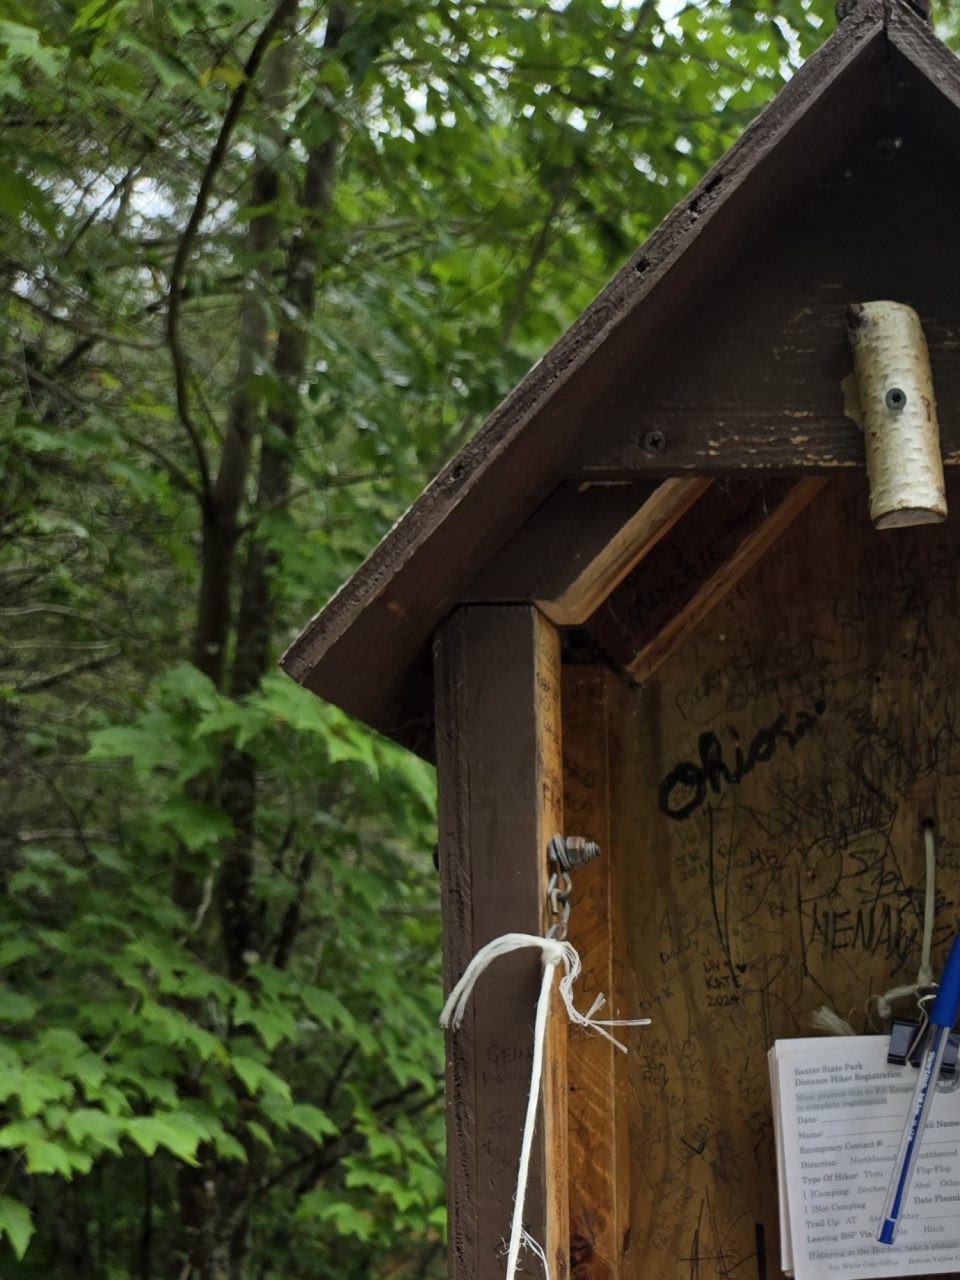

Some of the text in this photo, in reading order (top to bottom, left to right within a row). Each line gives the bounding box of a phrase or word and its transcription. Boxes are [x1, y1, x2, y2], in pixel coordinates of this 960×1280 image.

[794, 1062, 863, 1076] Baxter State Park
[794, 1070, 902, 1087] Distance Hiker Registration
[848, 1088, 864, 1097] this
[865, 1088, 874, 1096] to
[805, 1100, 841, 1112] complete
[842, 1097, 888, 1109] registration
[800, 1141, 875, 1154] Emergency Contact
[800, 1155, 896, 1170] Direction: Northbound
[801, 1176, 822, 1185] Type
[822, 1174, 834, 1182] Of
[864, 1170, 884, 1178] Thru
[857, 1186, 888, 1194] Birches
[914, 1181, 932, 1190] Abol
[831, 1202, 866, 1212] Camping
[914, 1196, 933, 1205] Date
[805, 1220, 825, 1229] Trail
[845, 1216, 857, 1225] AT
[924, 1224, 945, 1234] Hitch
[806, 1231, 858, 1244] Leaving BSP
[814, 1250, 846, 1261] staying
[848, 1249, 856, 1257] at
[857, 1248, 870, 1256] the
[905, 1243, 923, 1252] take
[931, 1240, 959, 1251] picture
